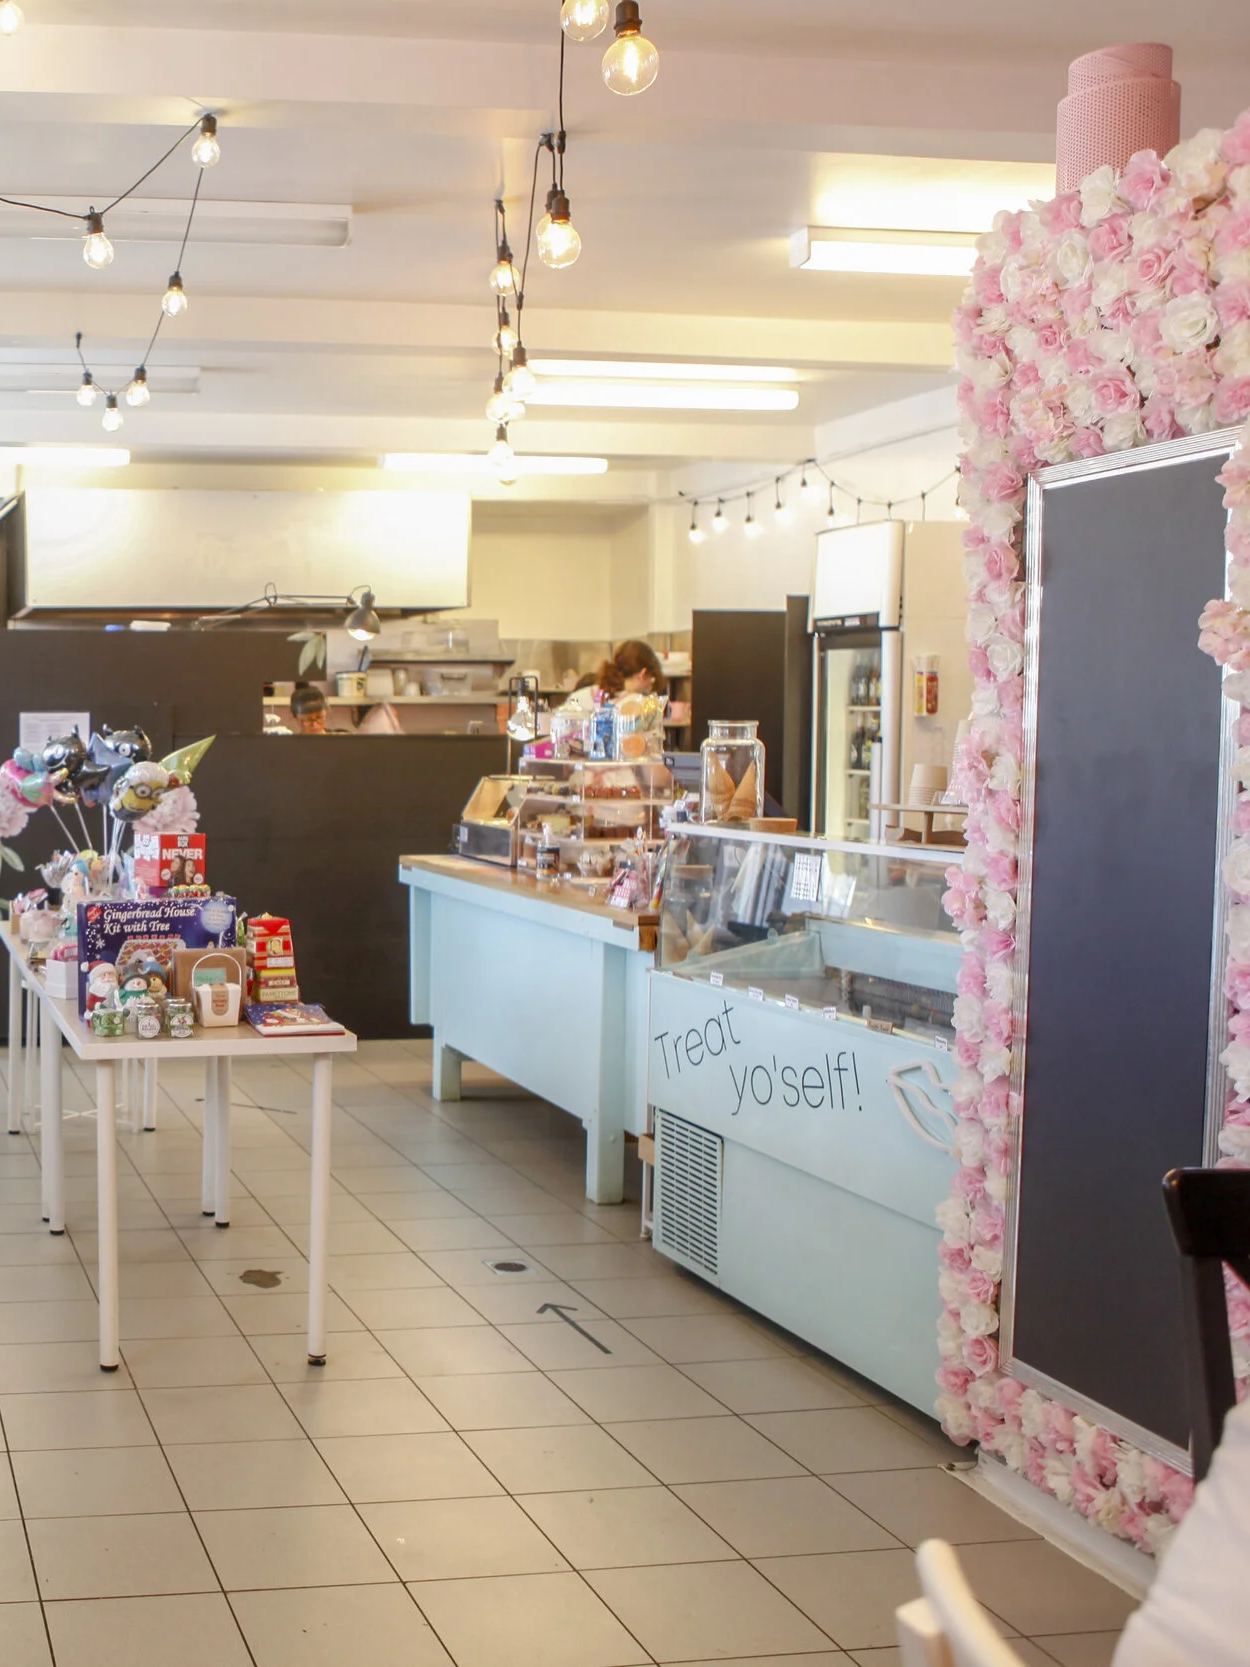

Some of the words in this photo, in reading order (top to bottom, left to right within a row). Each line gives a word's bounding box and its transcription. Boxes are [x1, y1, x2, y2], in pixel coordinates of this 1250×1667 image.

[162, 848, 203, 860] NEVER
[103, 906, 162, 922] Gingerbread
[164, 906, 196, 918] House
[103, 921, 122, 935] Kit
[123, 921, 148, 933] with
[150, 920, 170, 931] Tree
[654, 1000, 741, 1079] Treat
[729, 1052, 863, 1116] yo'self!
